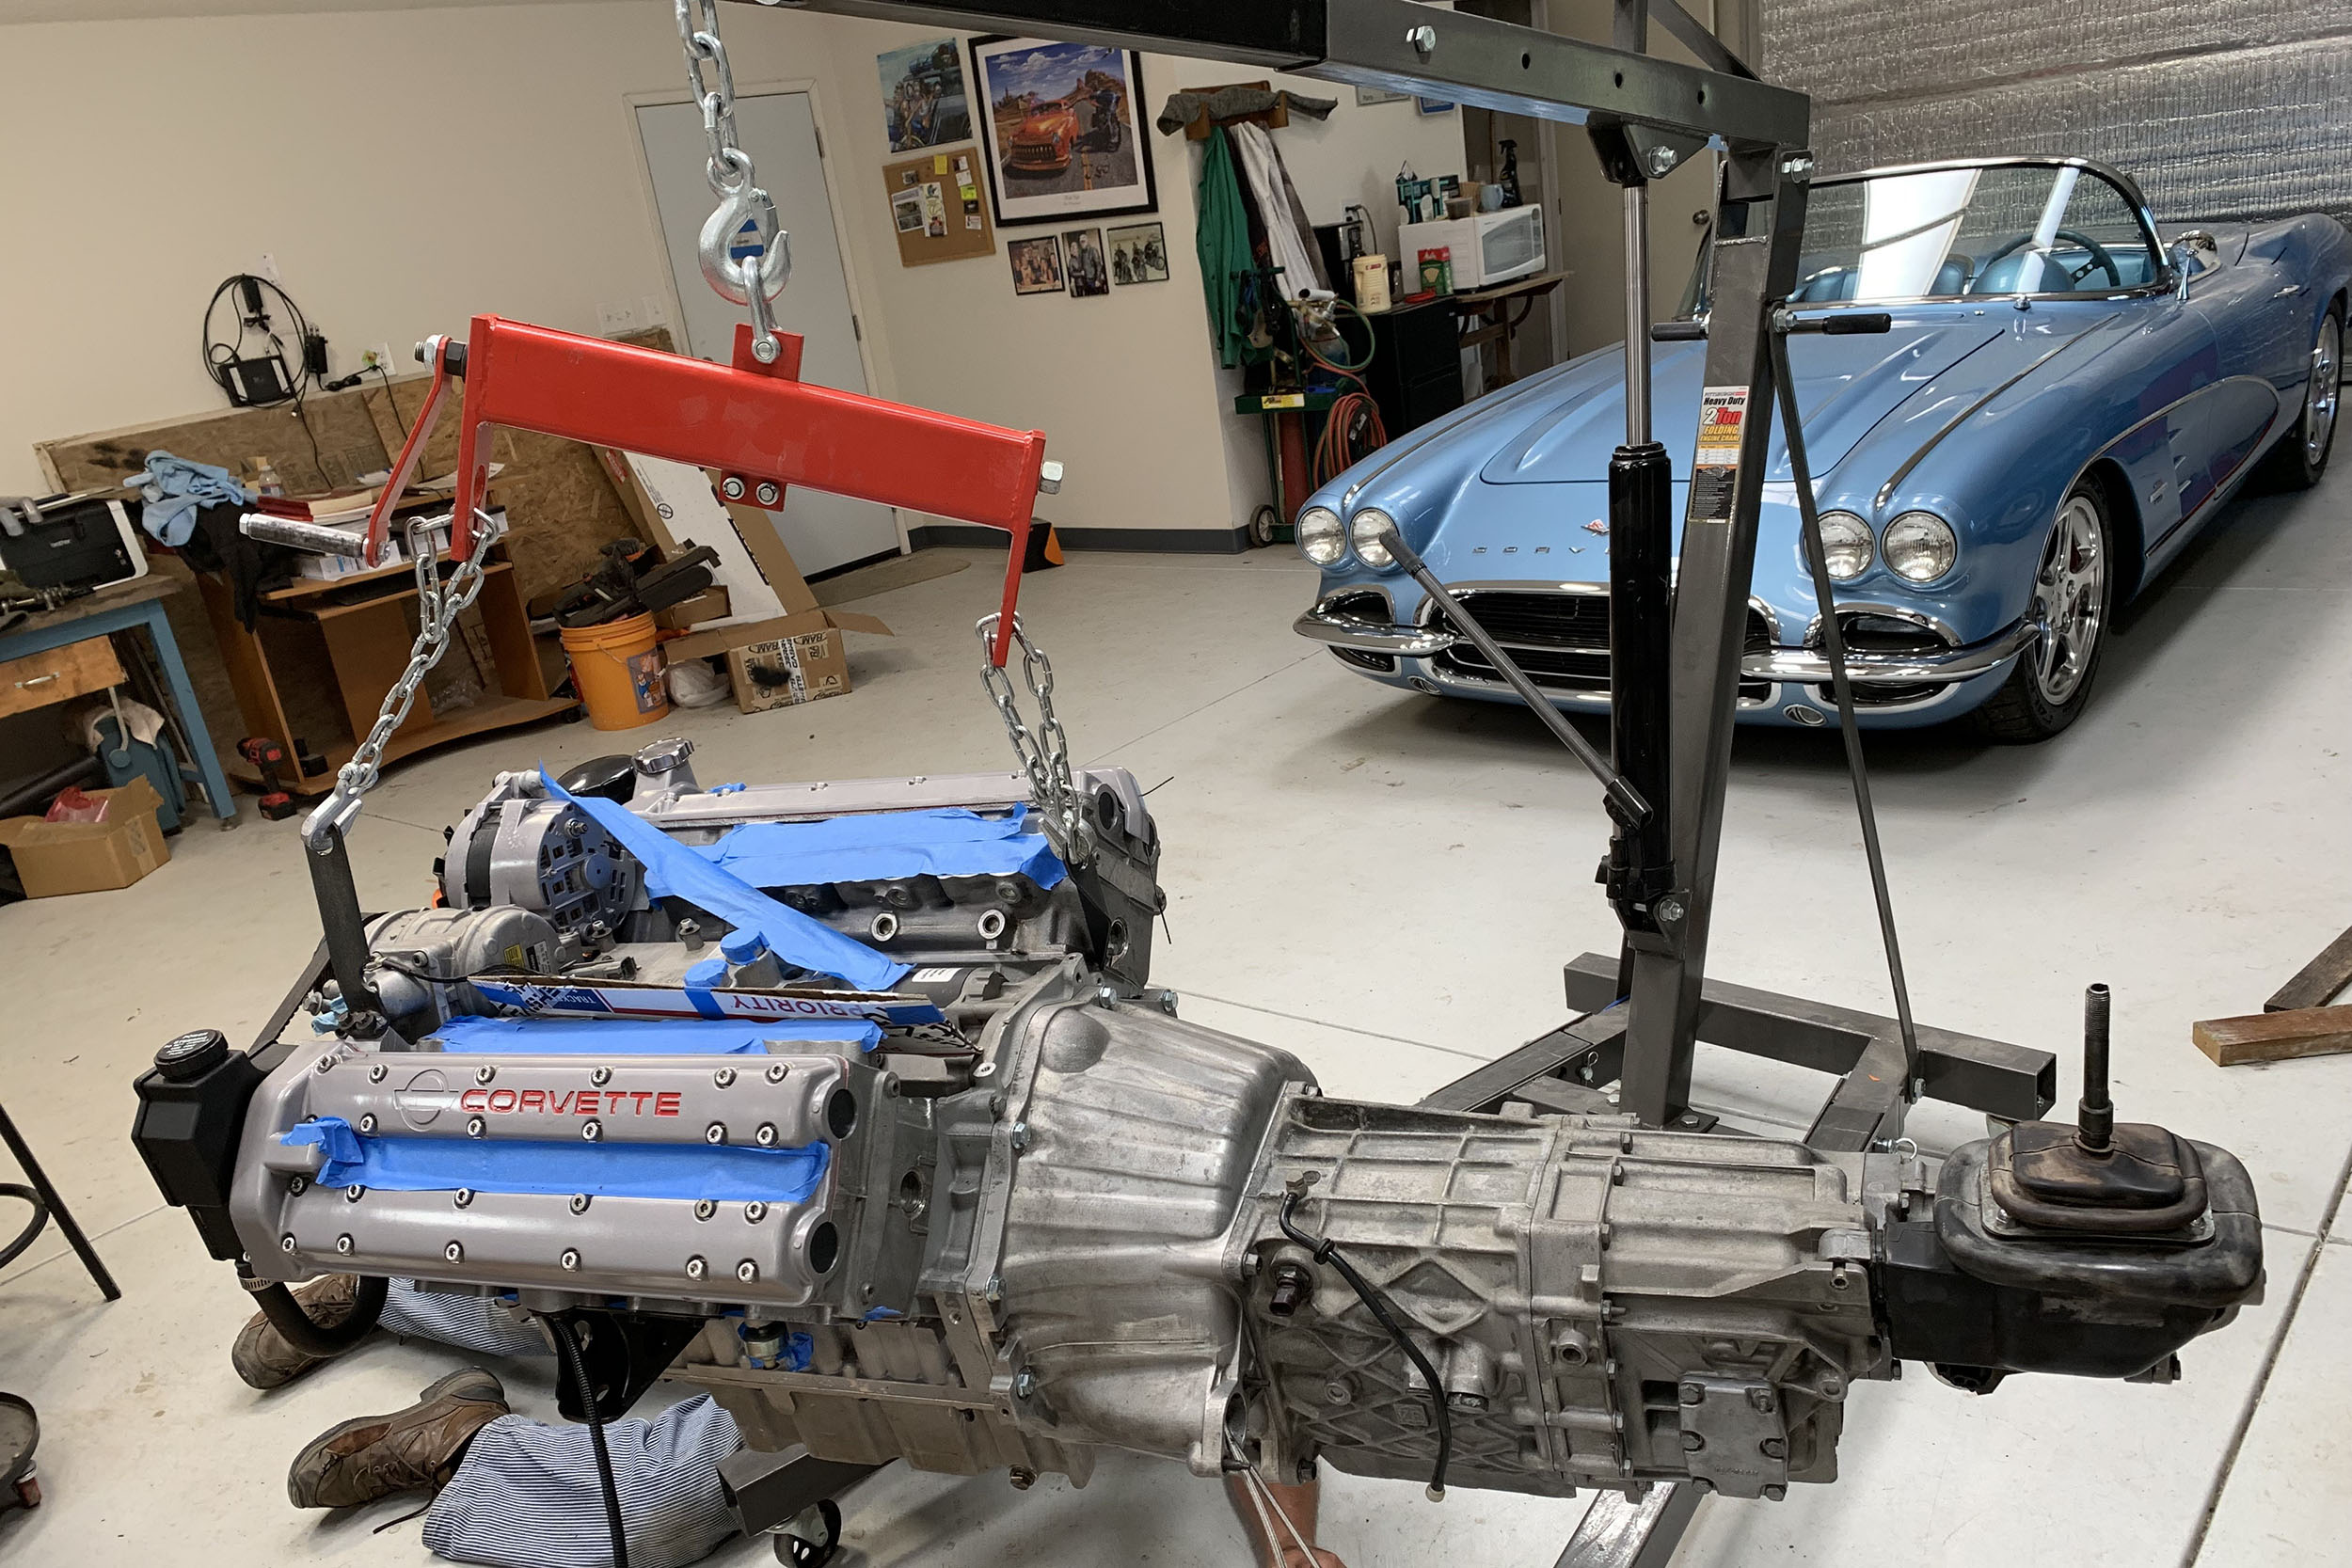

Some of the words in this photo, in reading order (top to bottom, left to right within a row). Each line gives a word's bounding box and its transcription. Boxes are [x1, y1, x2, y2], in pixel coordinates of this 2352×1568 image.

[1704, 397, 1727, 405] Heavy
[1727, 396, 1745, 405] Duty
[1715, 406, 1742, 425] Ton
[1704, 425, 1740, 435] FOLDING
[1699, 434, 1722, 442] ENGINE
[1722, 434, 1741, 443] CRANE
[1472, 546, 1610, 555] CORV
[561, 993, 596, 1005] TRACK
[734, 995, 865, 1016] PRIORITY
[460, 1088, 681, 1117] CORVETTE
